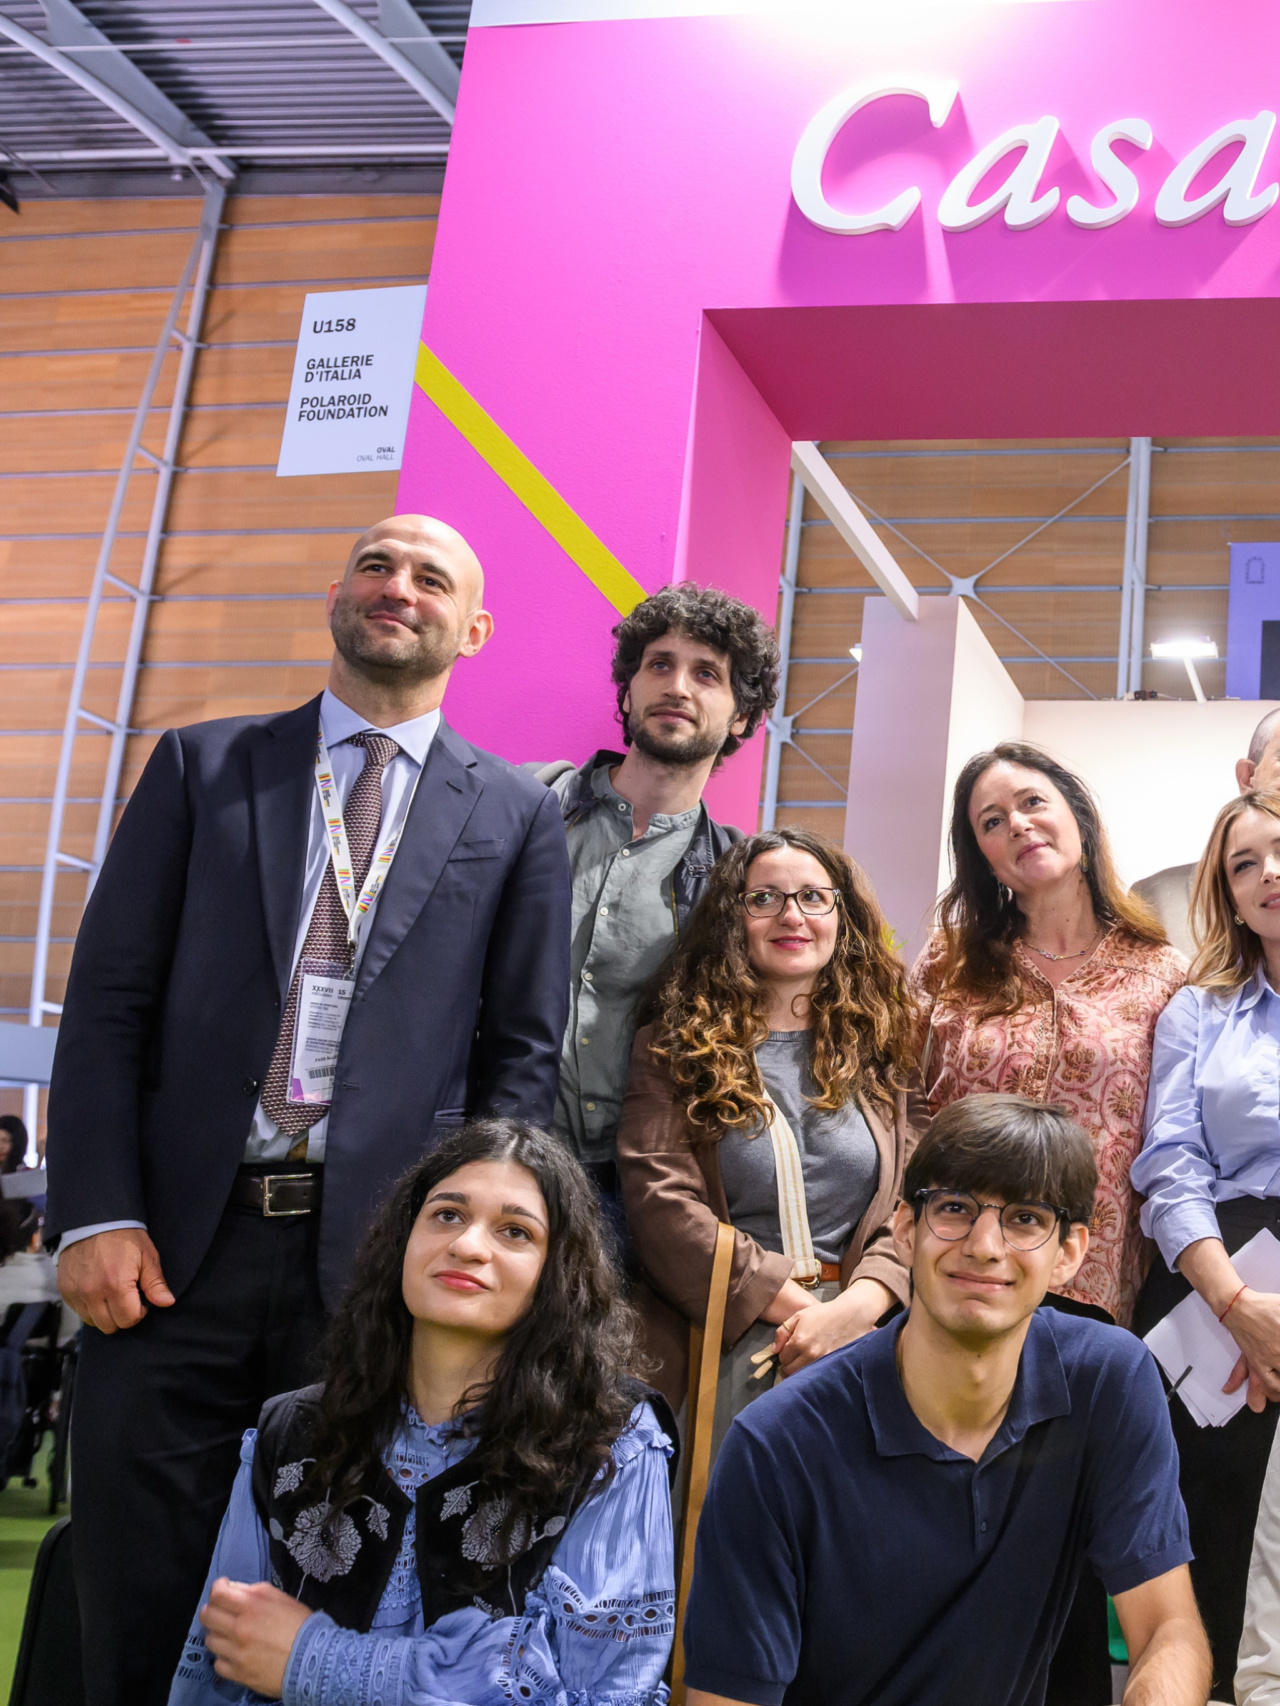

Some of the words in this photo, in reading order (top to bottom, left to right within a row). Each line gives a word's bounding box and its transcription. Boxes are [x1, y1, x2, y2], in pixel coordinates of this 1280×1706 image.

[791, 78, 1280, 236] Casa
[313, 318, 356, 334] U158
[307, 354, 374, 370] GALLERIE
[304, 368, 362, 383] D'ITALIA
[300, 393, 372, 409] POLAROID
[298, 405, 388, 422] FOUNDATION
